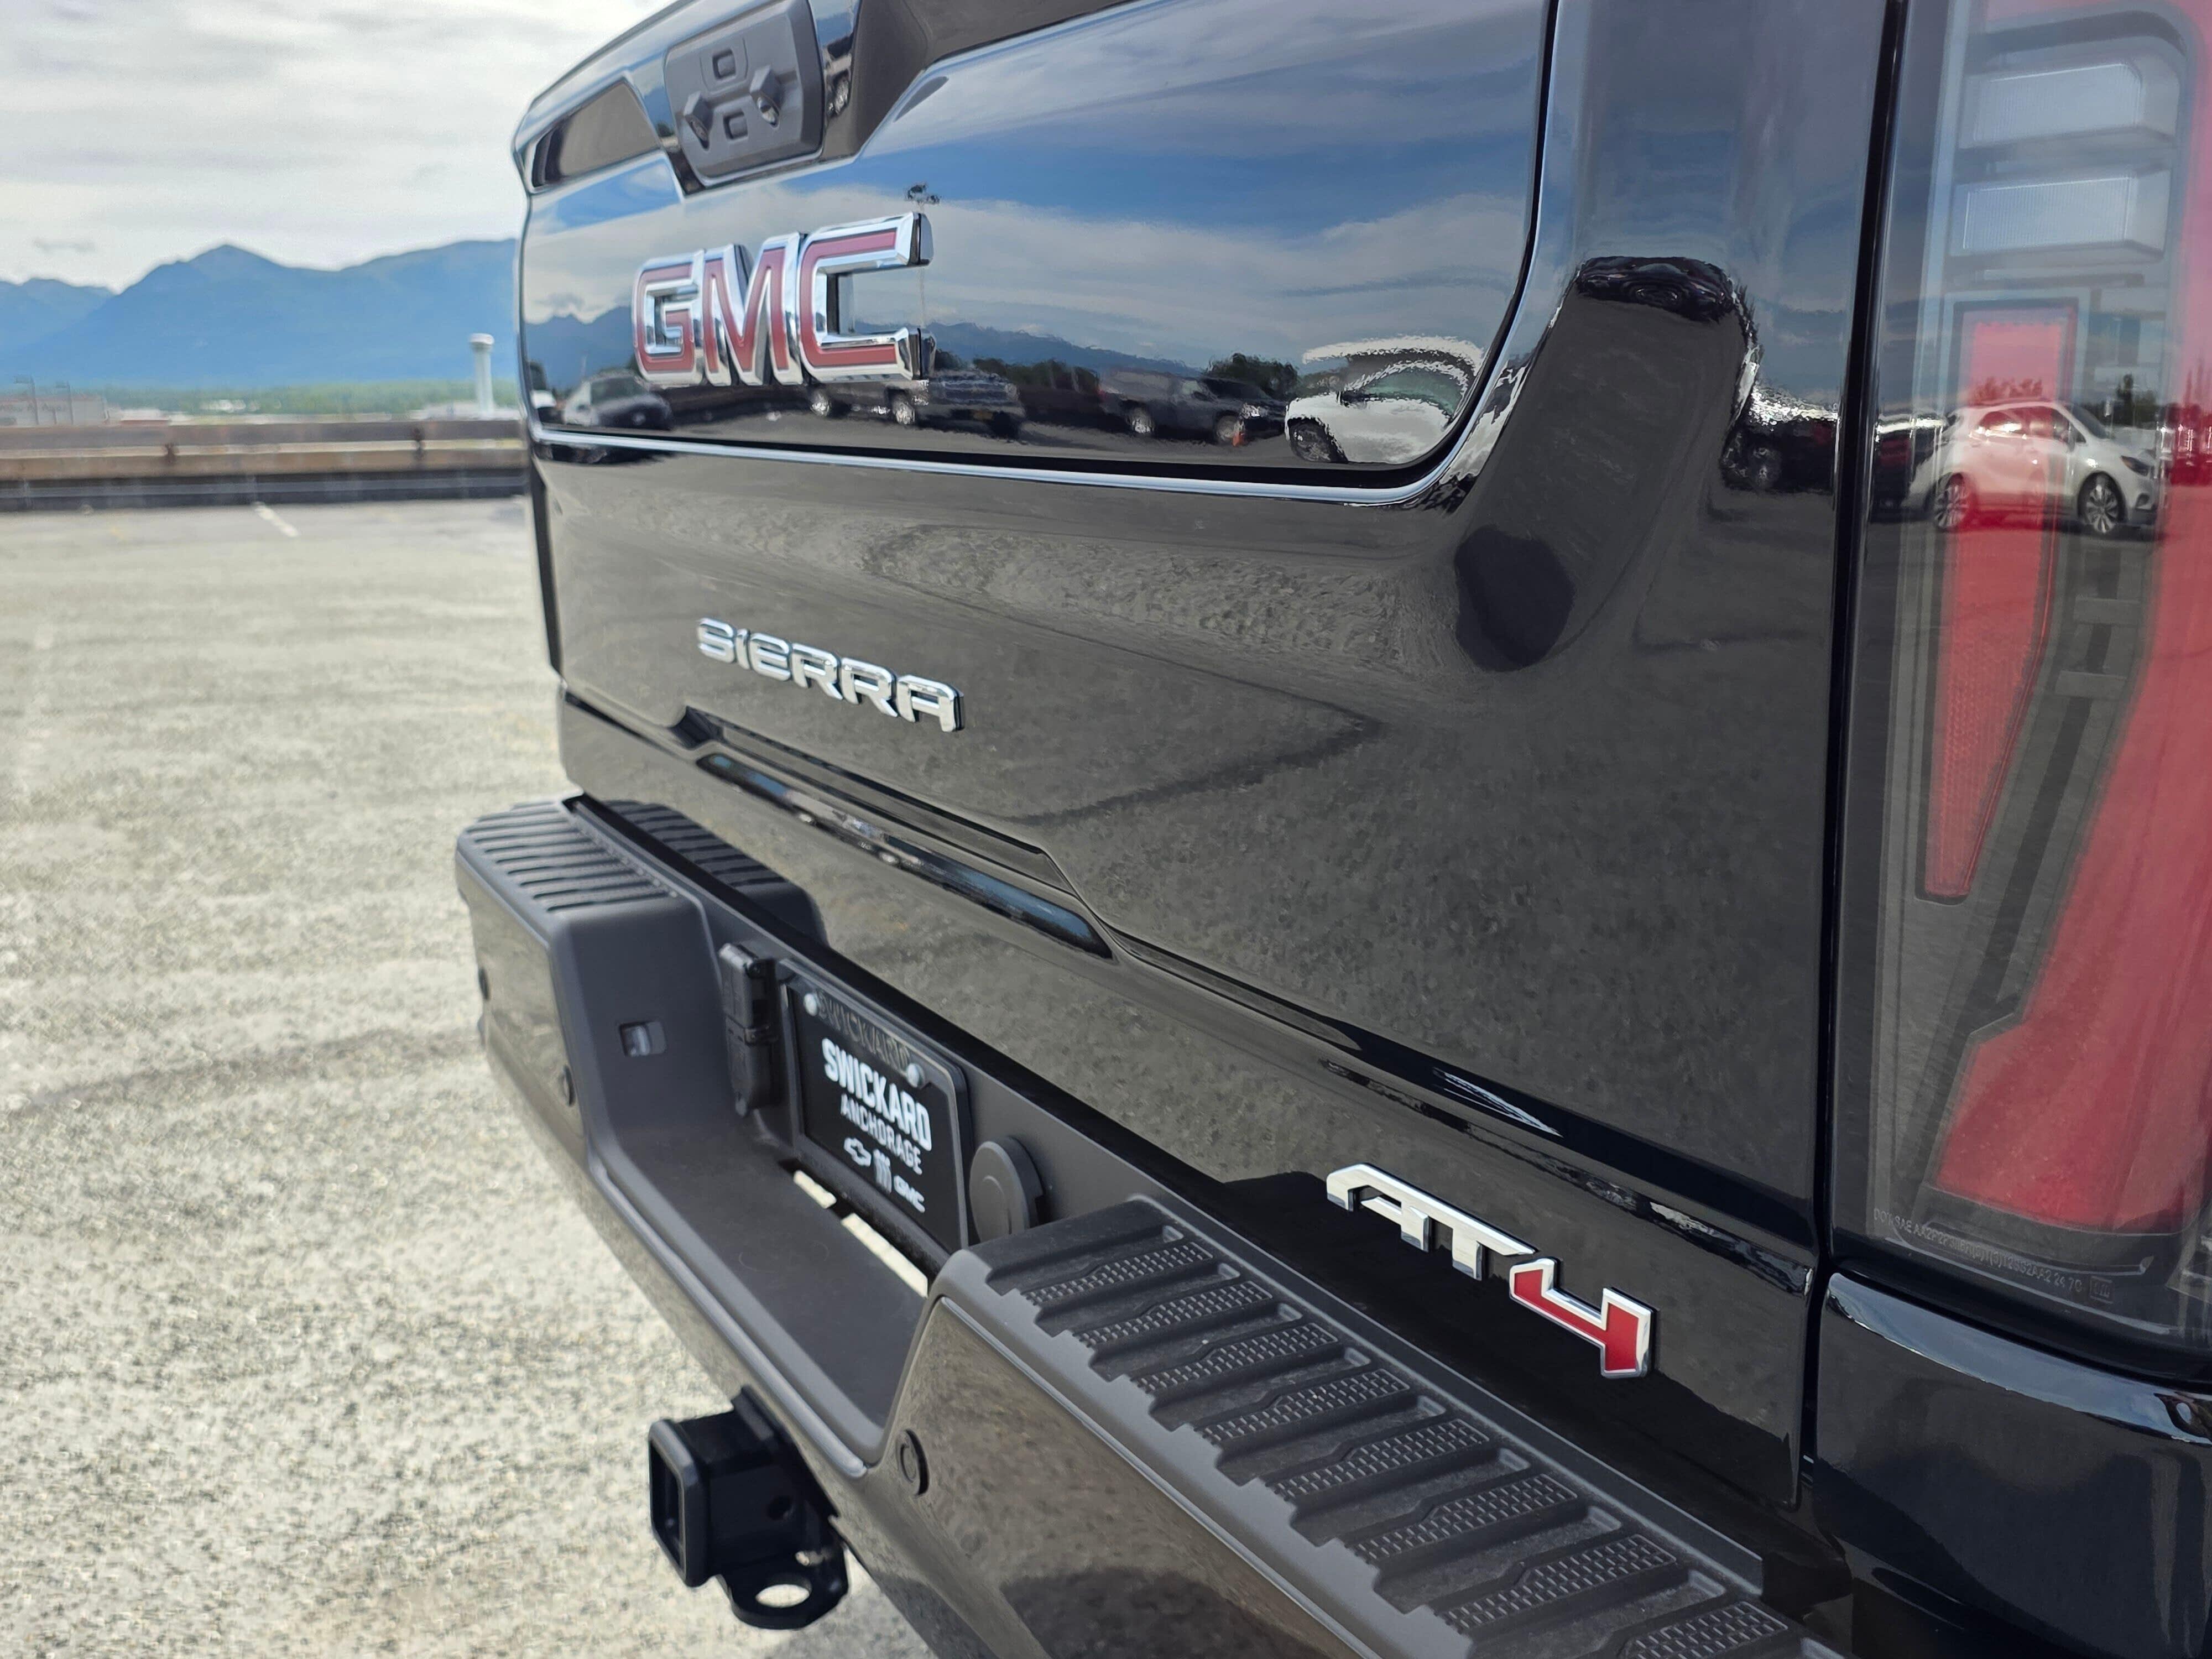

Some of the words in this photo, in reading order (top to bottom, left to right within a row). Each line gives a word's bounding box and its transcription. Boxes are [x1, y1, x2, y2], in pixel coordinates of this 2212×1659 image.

[632, 212, 935, 387] GMC
[697, 618, 964, 732] SIERRA
[822, 1037, 932, 1151] SWICKARD
[841, 1093, 923, 1175] ANCHORAGE
[893, 1175, 925, 1213] GMC
[1326, 1163, 1653, 1378] AT4
